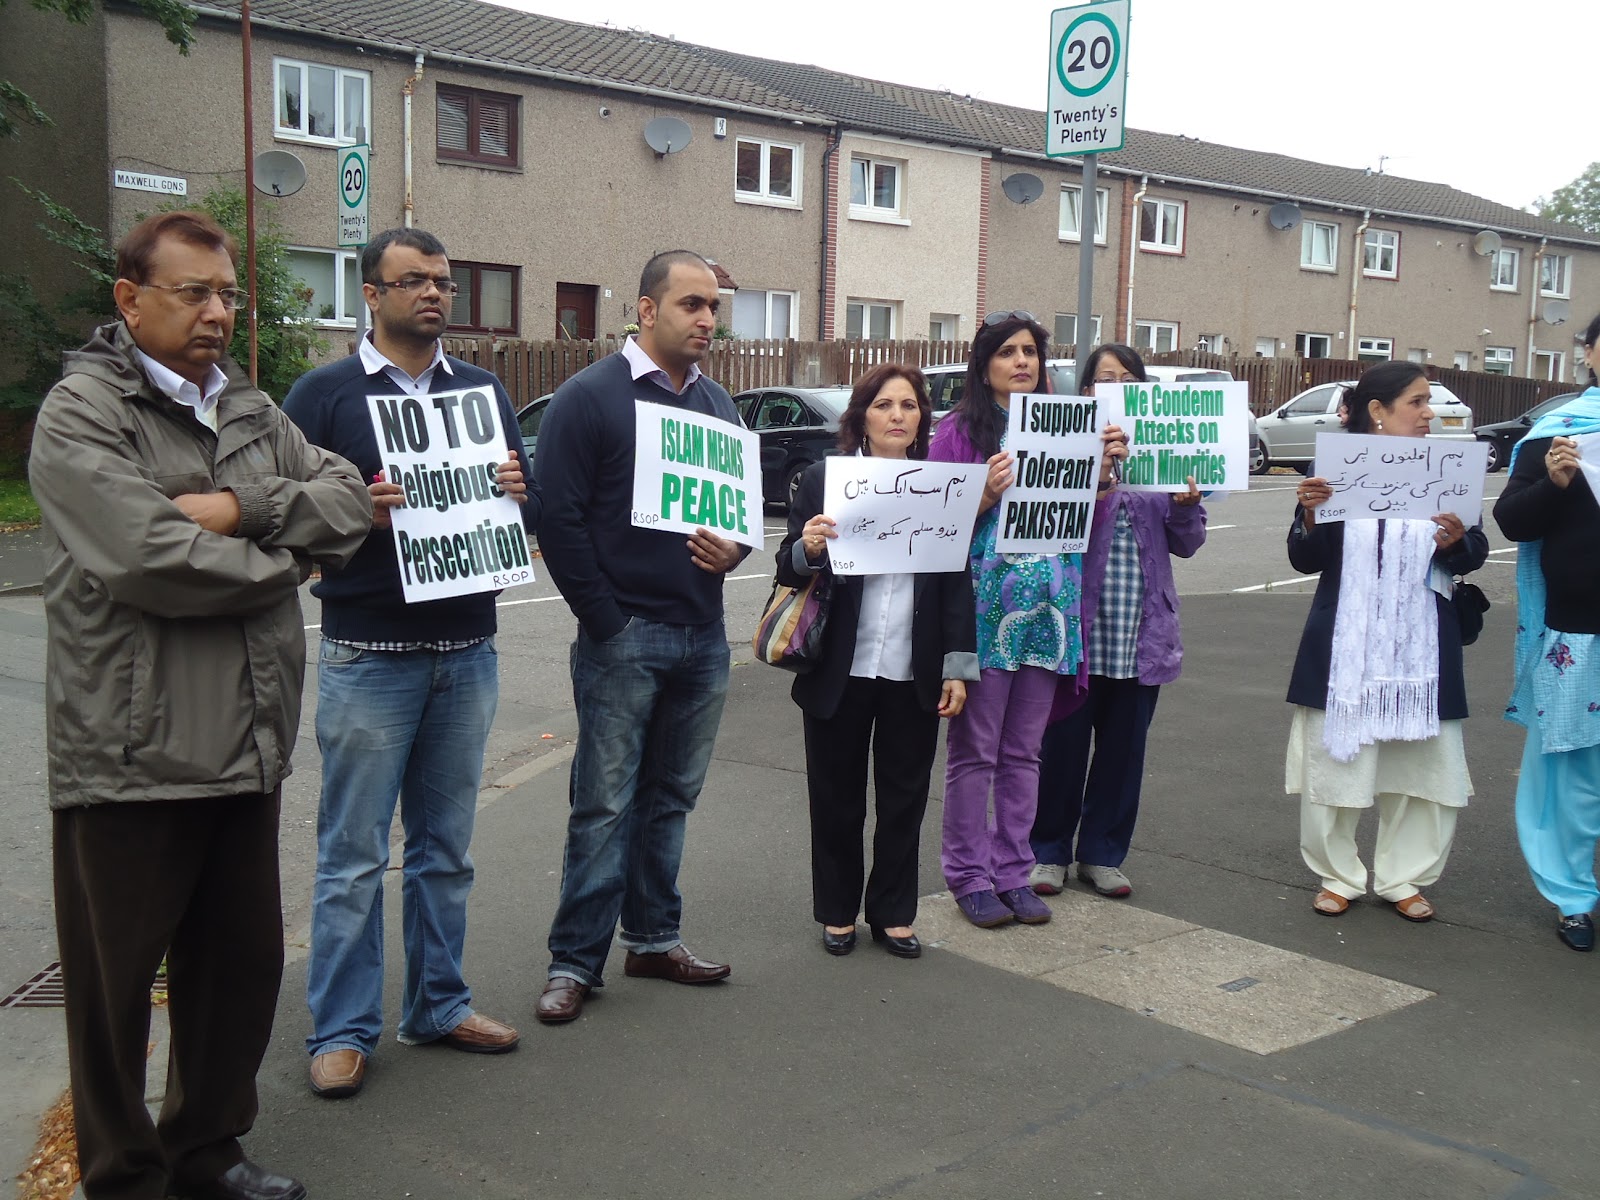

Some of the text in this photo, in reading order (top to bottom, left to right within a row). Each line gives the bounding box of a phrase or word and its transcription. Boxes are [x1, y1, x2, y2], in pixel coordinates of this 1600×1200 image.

[1067, 36, 1111, 73] 20
[1054, 104, 1118, 124] Twenty's
[1061, 126, 1107, 143] Plenty
[117, 174, 184, 191] MAXWELL GDNS
[345, 168, 362, 191] 20
[340, 214, 365, 226] Twenty's
[343, 229, 362, 240] Plenty
[1123, 383, 1224, 417] We Condemn
[376, 391, 495, 453] NO TO
[1020, 396, 1098, 437] I support
[1133, 418, 1219, 445] Attacks on
[661, 417, 744, 481] ISLAM MEANS
[1016, 450, 1095, 489] Tolerant
[1157, 448, 1226, 485] Minorities
[661, 472, 749, 535] PEACE
[1320, 509, 1346, 517] RSOP
[633, 511, 659, 525] RSOP
[1004, 501, 1090, 539] PAKISTAN
[397, 519, 530, 586] Persecution
[1061, 542, 1084, 553] RSOP
[833, 560, 855, 571] RSOP
[493, 570, 529, 588] RSOP
